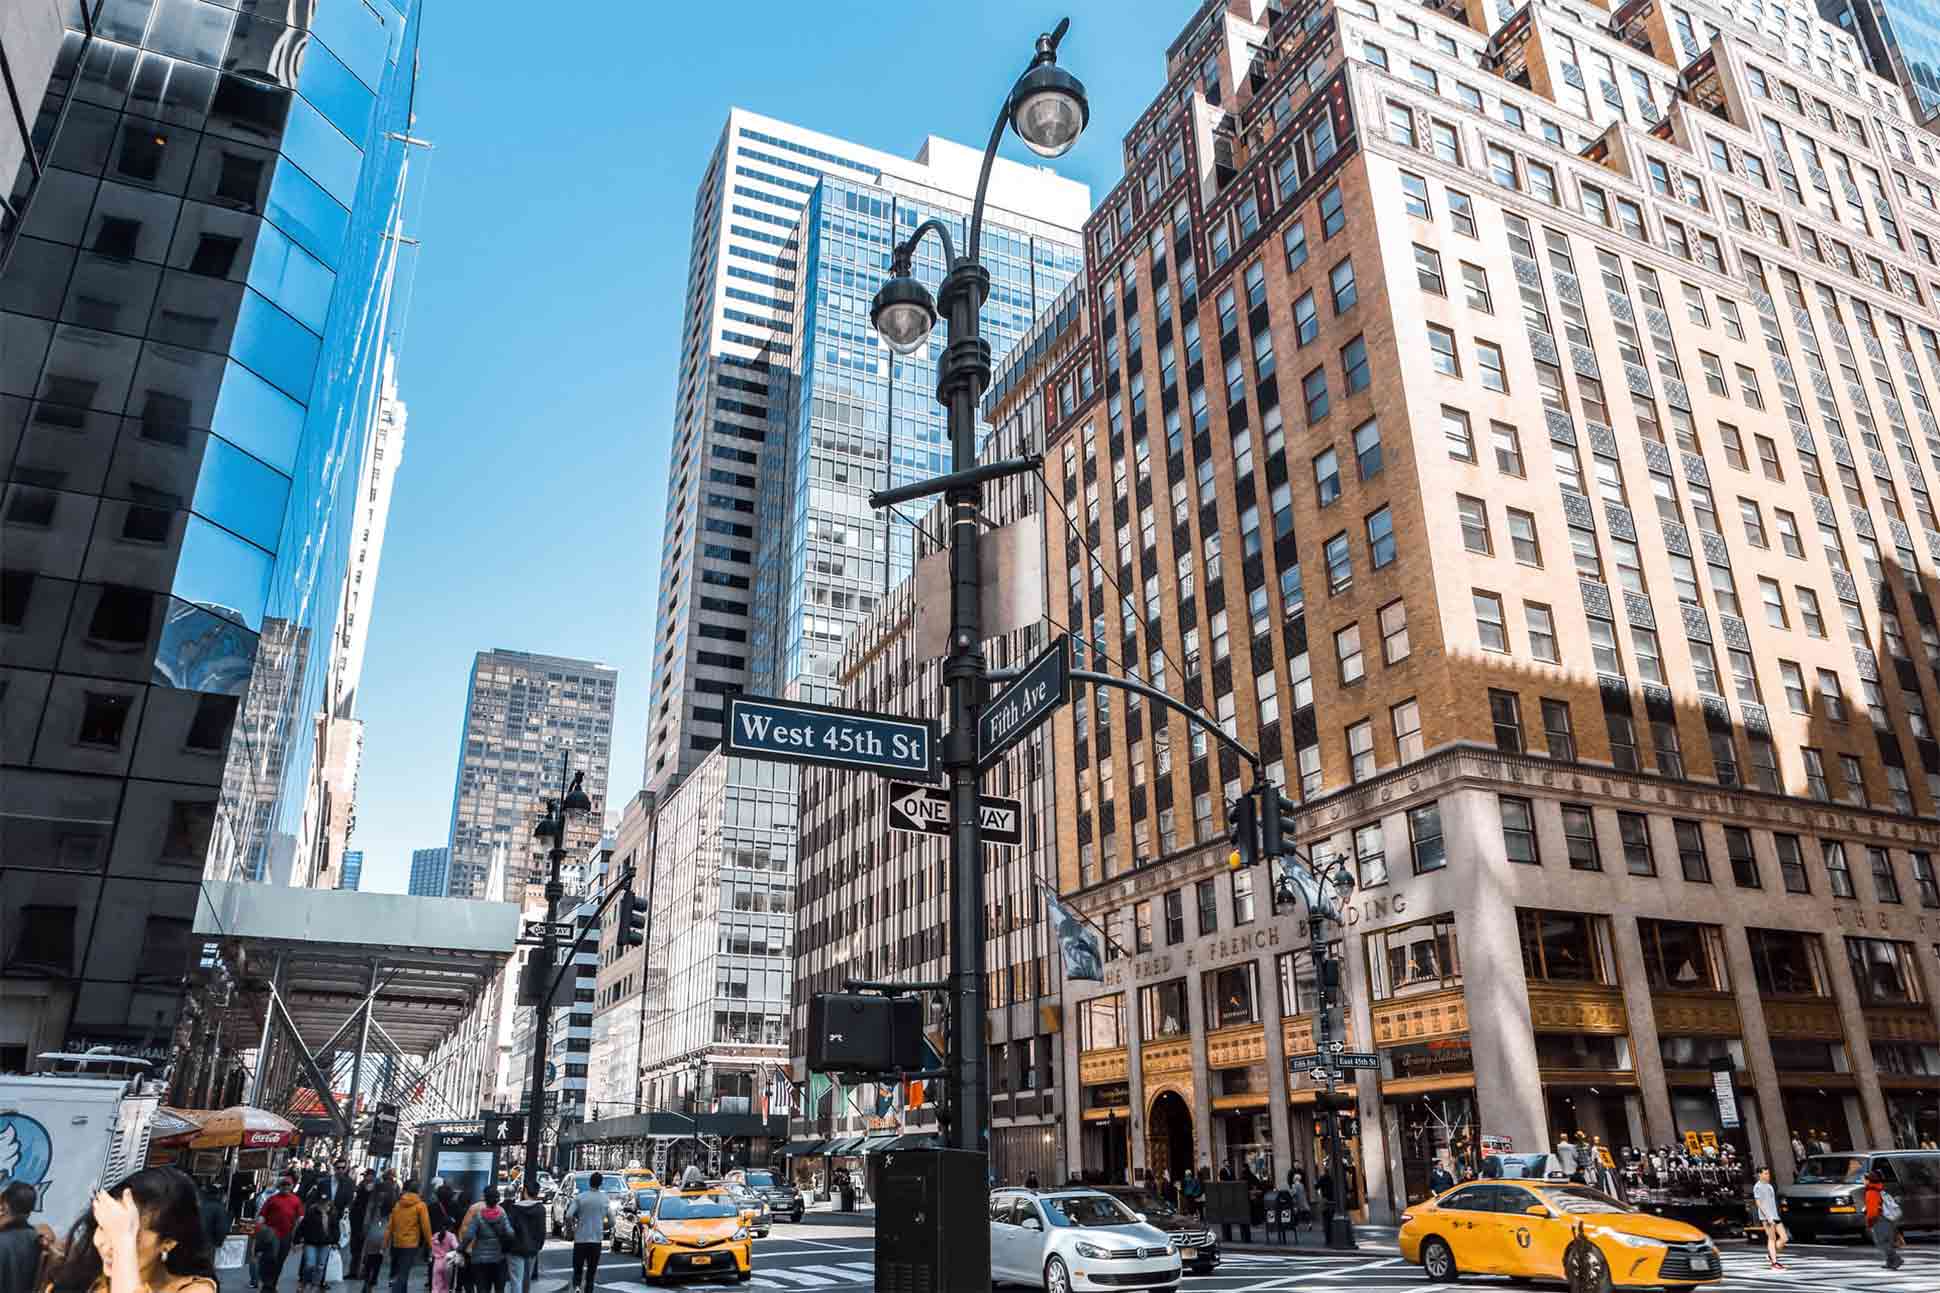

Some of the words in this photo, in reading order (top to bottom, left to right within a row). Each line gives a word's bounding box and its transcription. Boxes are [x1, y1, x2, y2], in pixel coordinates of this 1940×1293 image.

[990, 700, 1019, 745] Fifth
[1021, 681, 1047, 718] Ave
[739, 713, 815, 748] West
[822, 726, 883, 756] 45th
[892, 734, 921, 760] St
[904, 799, 947, 821] ONE
[1209, 926, 1280, 961] FRENCH
[1369, 1058, 1376, 1066] St
